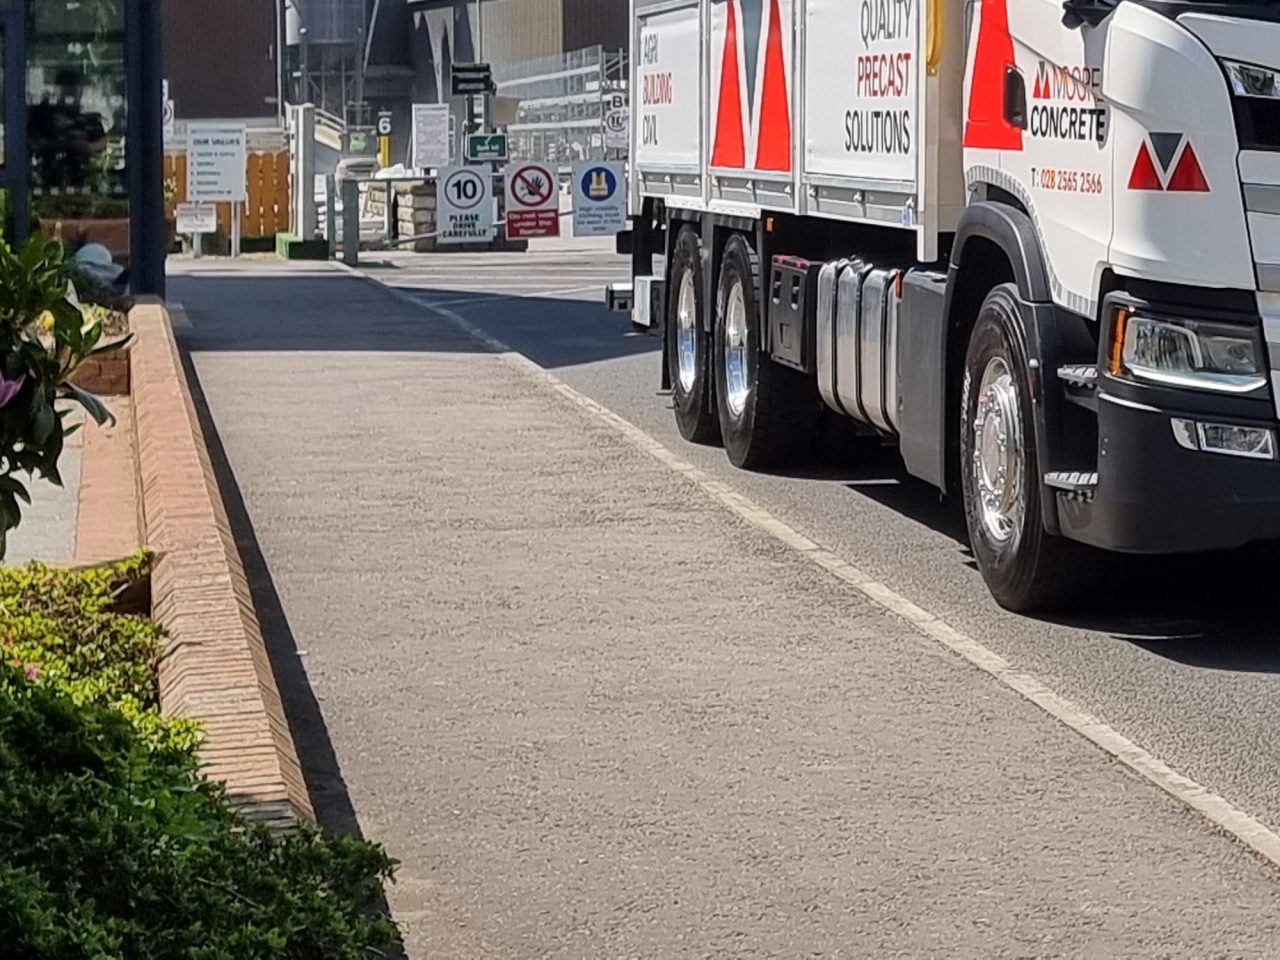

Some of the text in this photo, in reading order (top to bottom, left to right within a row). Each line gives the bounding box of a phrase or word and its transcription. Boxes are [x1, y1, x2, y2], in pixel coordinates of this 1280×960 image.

[643, 33, 659, 65] AGRI
[643, 72, 672, 105] BUILDING
[856, 52, 912, 98] PRECAST
[1051, 63, 1105, 103] MOORE
[378, 117, 392, 135] 6
[844, 110, 911, 156] SOLUTIONS
[1030, 104, 1106, 142] CONCRETE
[452, 179, 477, 200] 10
[1040, 169, 1057, 190] 028
[1080, 172, 1104, 195] 2566
[449, 213, 479, 223] PLEASE
[453, 222, 476, 230] DRIVE
[442, 229, 487, 238] CAREFULLY
